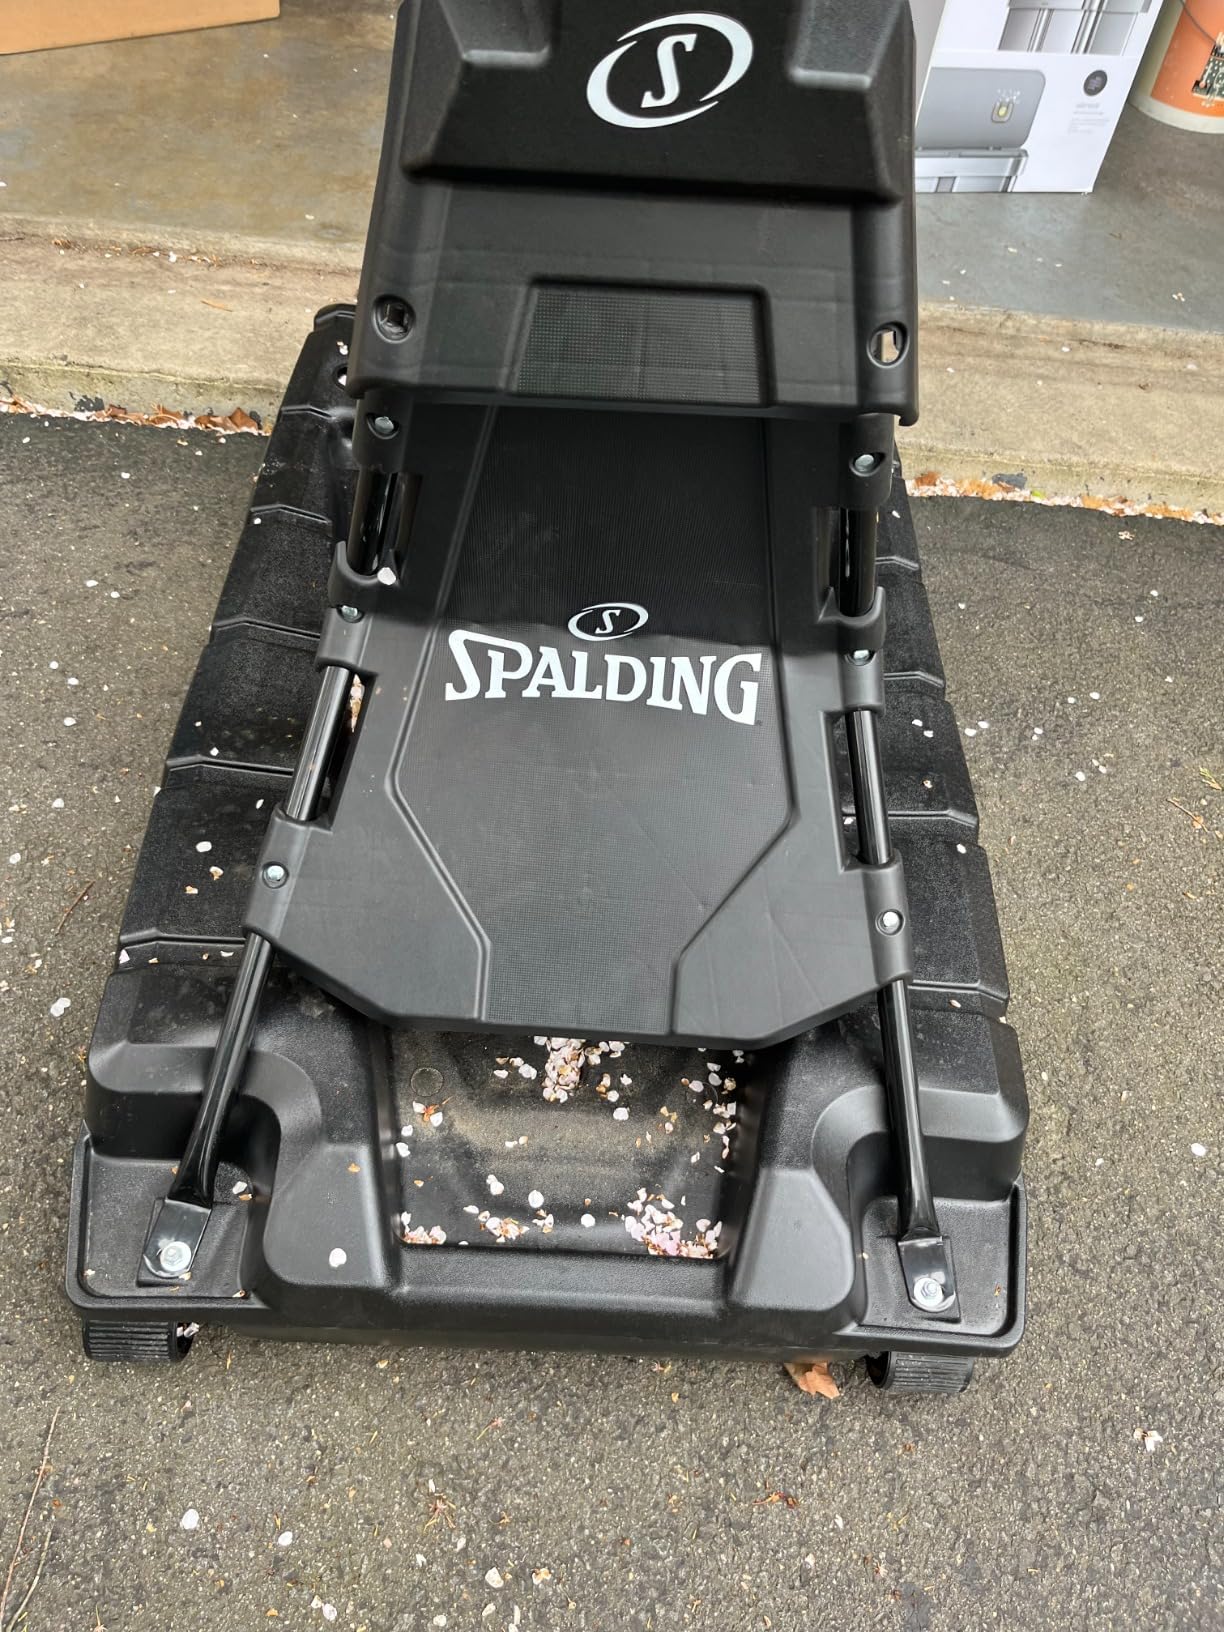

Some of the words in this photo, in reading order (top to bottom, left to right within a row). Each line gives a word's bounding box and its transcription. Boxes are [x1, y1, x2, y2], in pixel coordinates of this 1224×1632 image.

[640, 33, 698, 109] S
[595, 609, 621, 634] S
[445, 629, 762, 726] SPALDING
